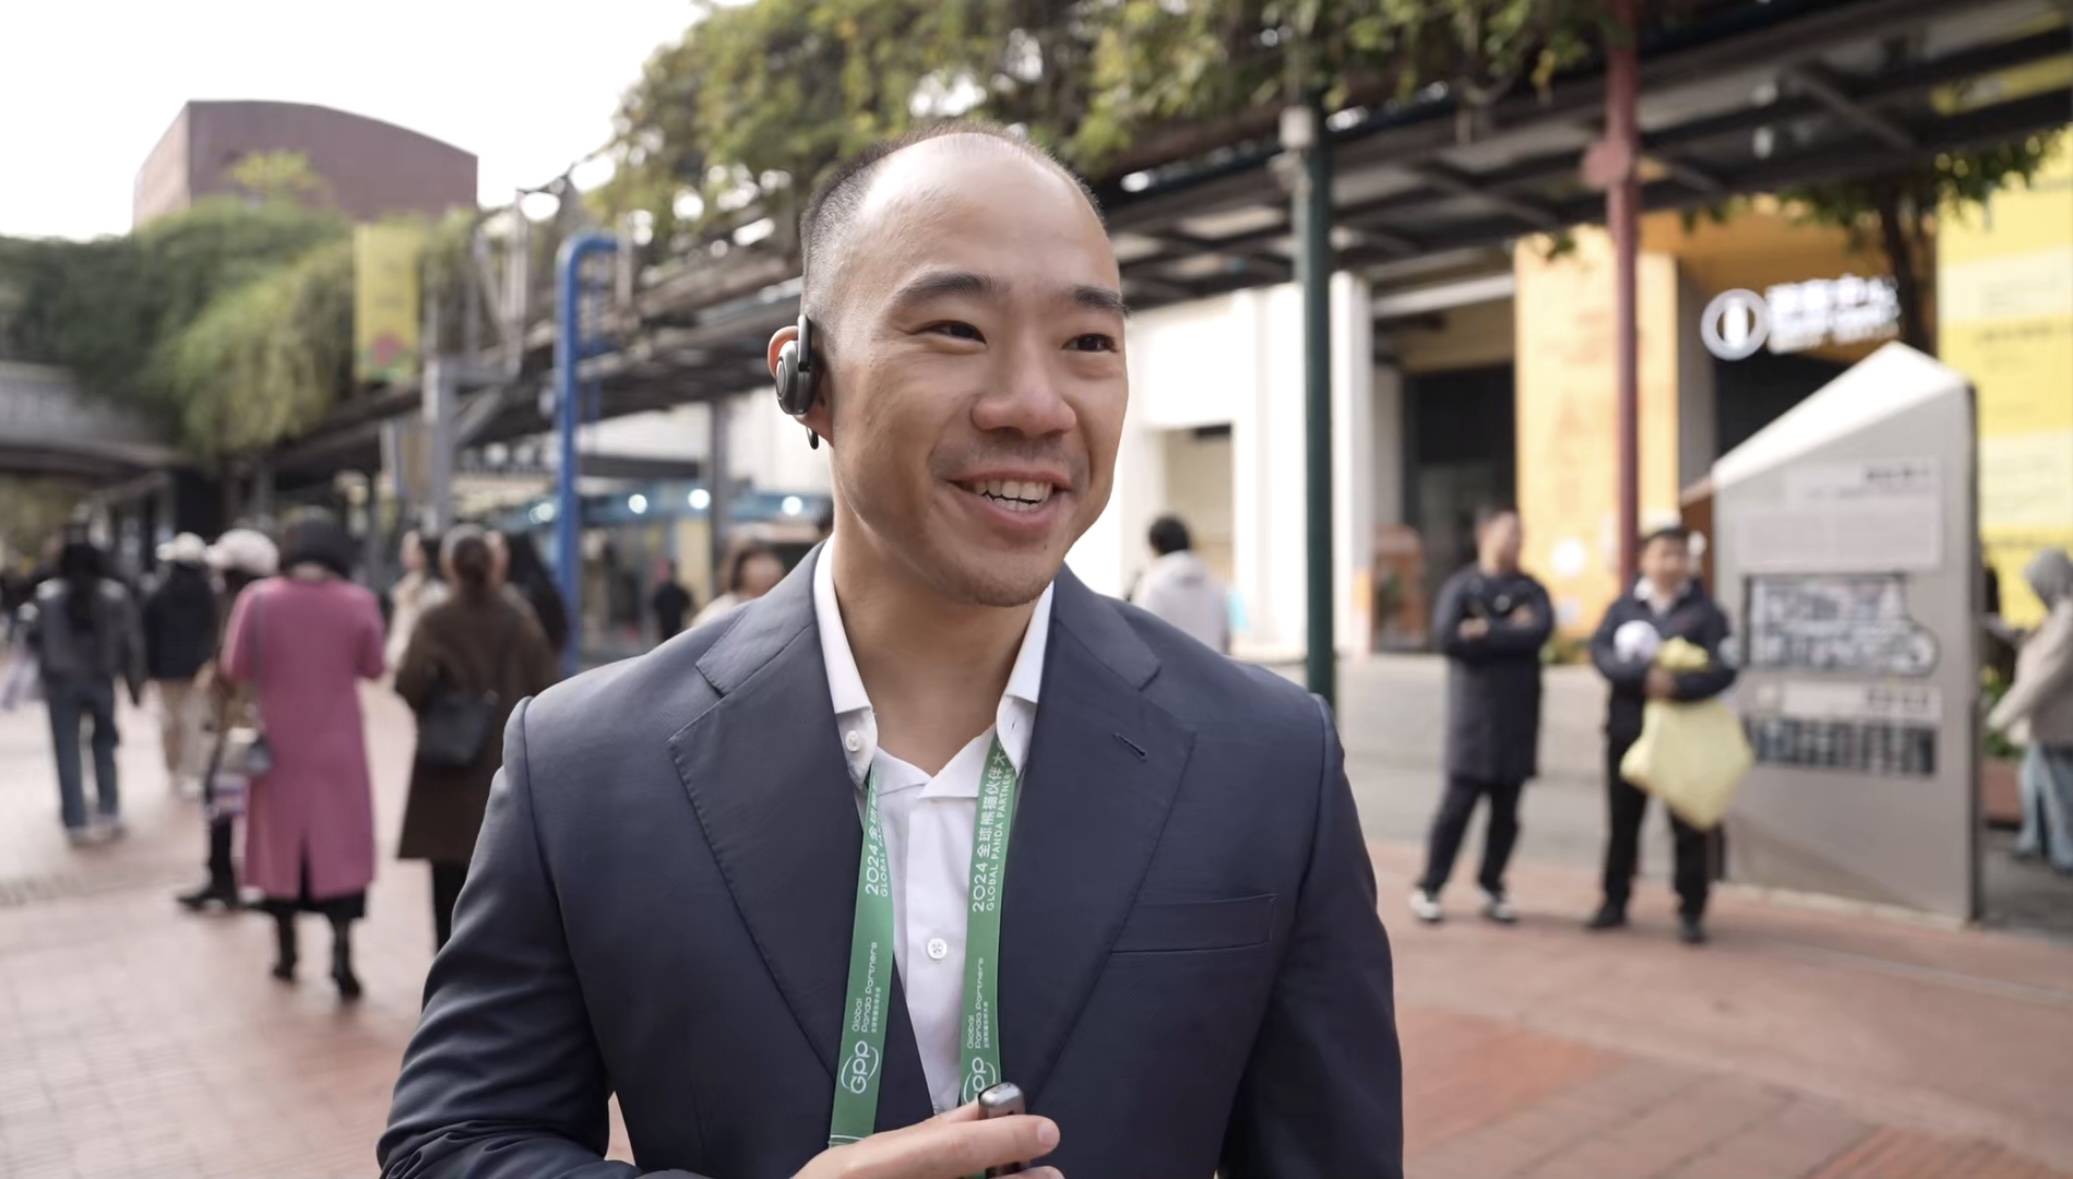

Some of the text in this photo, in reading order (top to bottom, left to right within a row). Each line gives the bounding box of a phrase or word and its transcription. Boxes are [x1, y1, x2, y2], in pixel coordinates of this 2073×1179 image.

[972, 742, 1006, 912] 2024 全球熊猫伙伴大
[991, 820, 1003, 859] PANDA
[865, 844, 879, 895] 2024
[880, 853, 889, 897] GLOBAL
[986, 864, 998, 911] GLOBAL
[865, 942, 878, 995] Partners
[852, 998, 862, 1033] Global
[861, 996, 872, 1033] Panda
[974, 957, 985, 1049] Panda Partners
